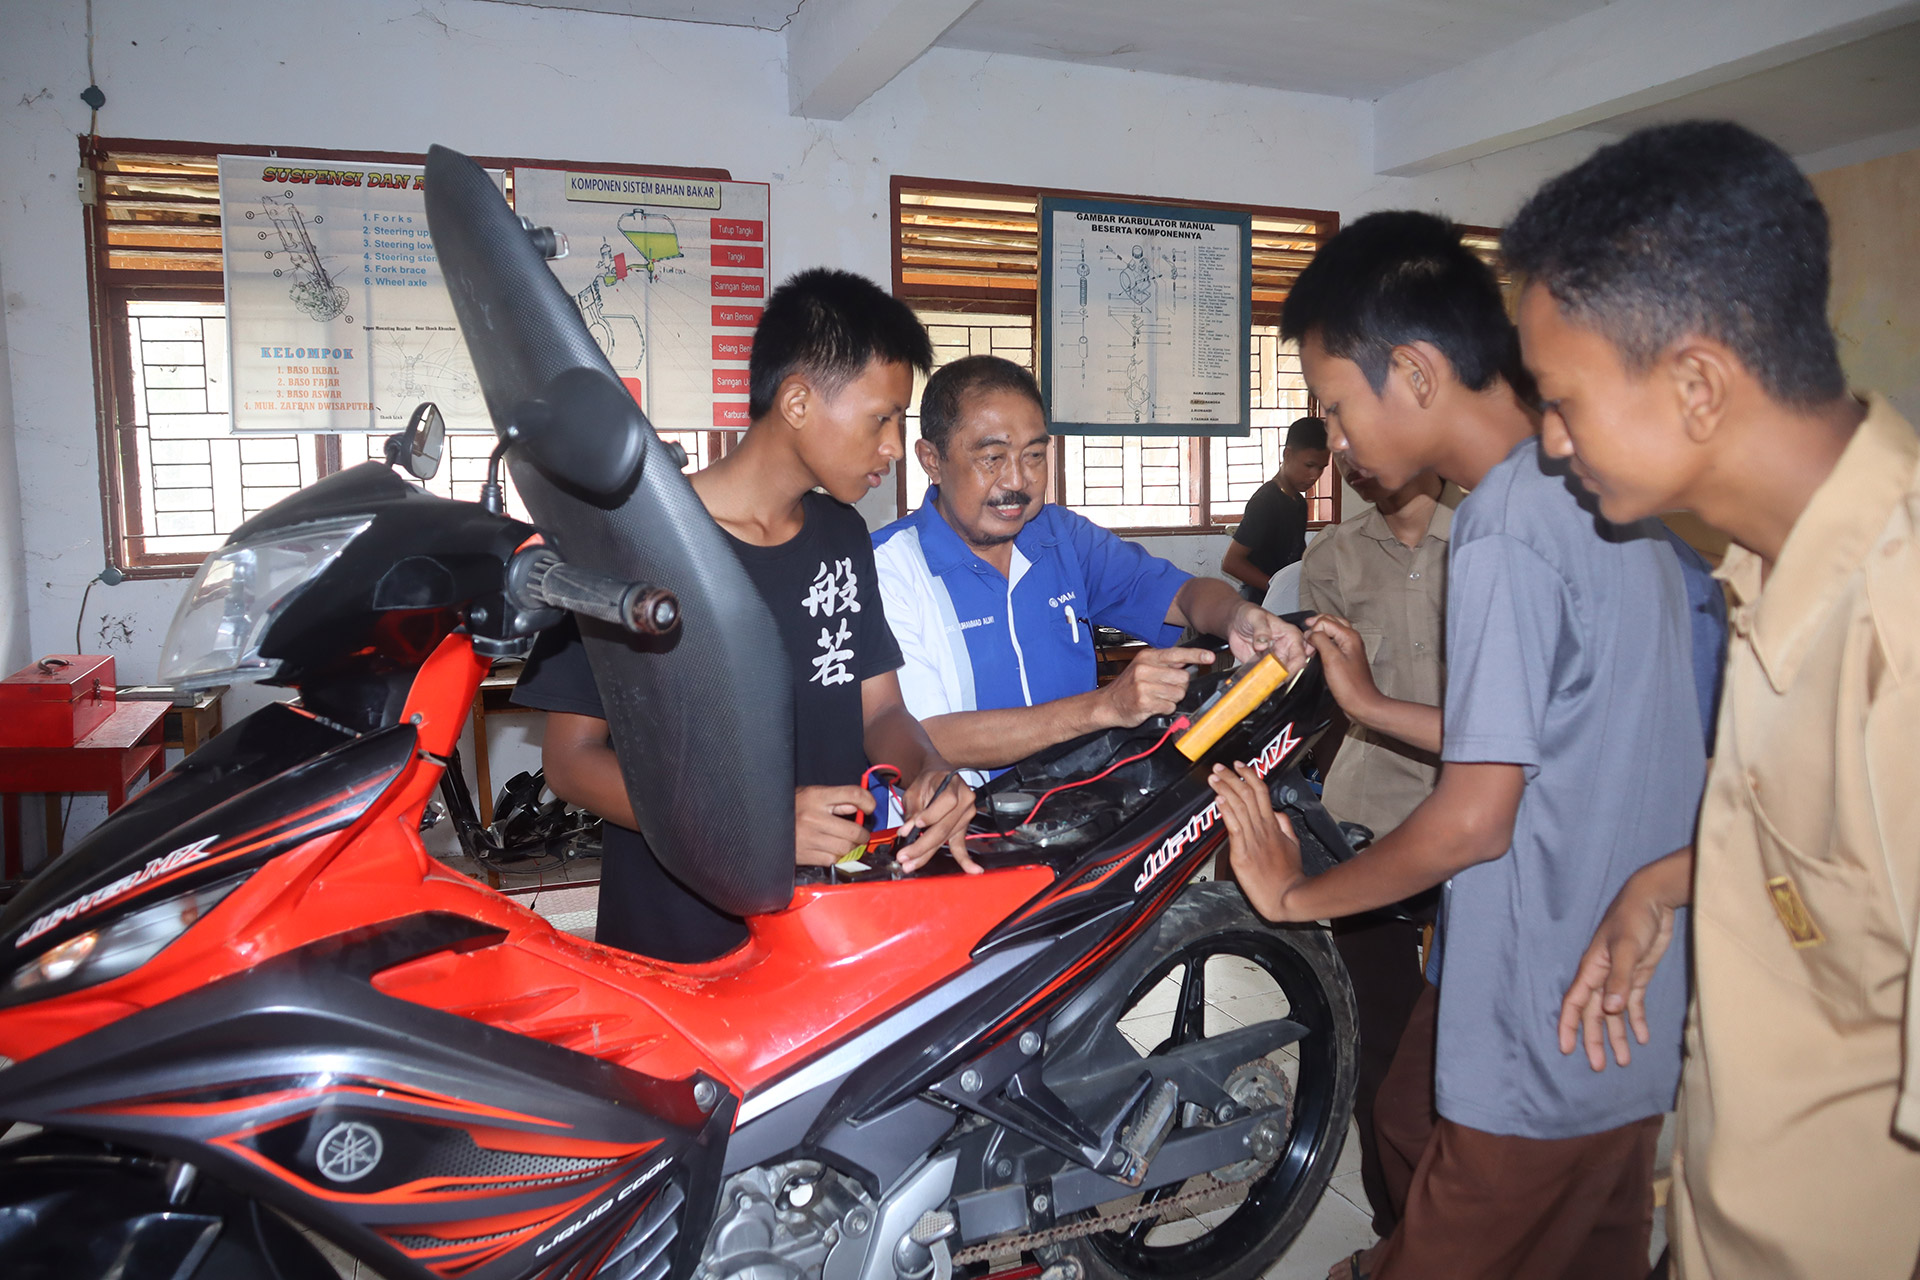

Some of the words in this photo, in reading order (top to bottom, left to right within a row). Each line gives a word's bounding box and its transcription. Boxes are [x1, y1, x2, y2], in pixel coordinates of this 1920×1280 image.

[262, 166, 364, 187] SUSPENSI
[367, 172, 410, 190] DAN
[412, 175, 425, 190] R
[571, 177, 621, 192] KOMPONEN
[623, 180, 653, 194] SISTEM
[655, 183, 685, 196] BAHAN
[686, 185, 715, 198] BAKAR
[1076, 212, 1116, 223] GAMBAR
[1118, 216, 1177, 228] KARBULATOR
[1179, 221, 1216, 231] MANUAL
[374, 226, 414, 238] Steering
[417, 230, 432, 238] up
[718, 224, 734, 236] Tutup
[736, 225, 754, 237] Tangki
[1091, 224, 1132, 234] BESERTA
[1135, 227, 1202, 240] KOMPONENNYA
[374, 240, 415, 251] Steering
[417, 241, 434, 249] low
[375, 252, 415, 263] Steering
[727, 251, 746, 263] Tangki
[375, 265, 397, 273] Fork
[400, 266, 427, 274] brace
[375, 277, 405, 286] Wheel
[408, 278, 428, 287] axle
[741, 282, 760, 292] Bensin
[720, 312, 733, 320] Kran
[735, 312, 754, 321] Bensin
[260, 347, 354, 360] KELOMPOK
[718, 343, 738, 355] Selang
[739, 344, 752, 352] Ben
[287, 366, 309, 374] BASO
[312, 366, 340, 375] IKBAL
[288, 378, 310, 386] BASO
[313, 378, 340, 388] FAJAR
[717, 376, 742, 388] Saringan
[287, 390, 309, 398] BASO
[312, 390, 342, 399] ASWAR
[254, 402, 278, 410] MUH.
[280, 402, 315, 410] ZAFRAN
[318, 402, 375, 411] DWISAPUTRA
[1057, 591, 1076, 604] YAM
[801, 557, 861, 686] 般若
[1134, 800, 1224, 893] JUPIT
[536, 1198, 614, 1257] LIQUID
[617, 1156, 674, 1202] COOL
